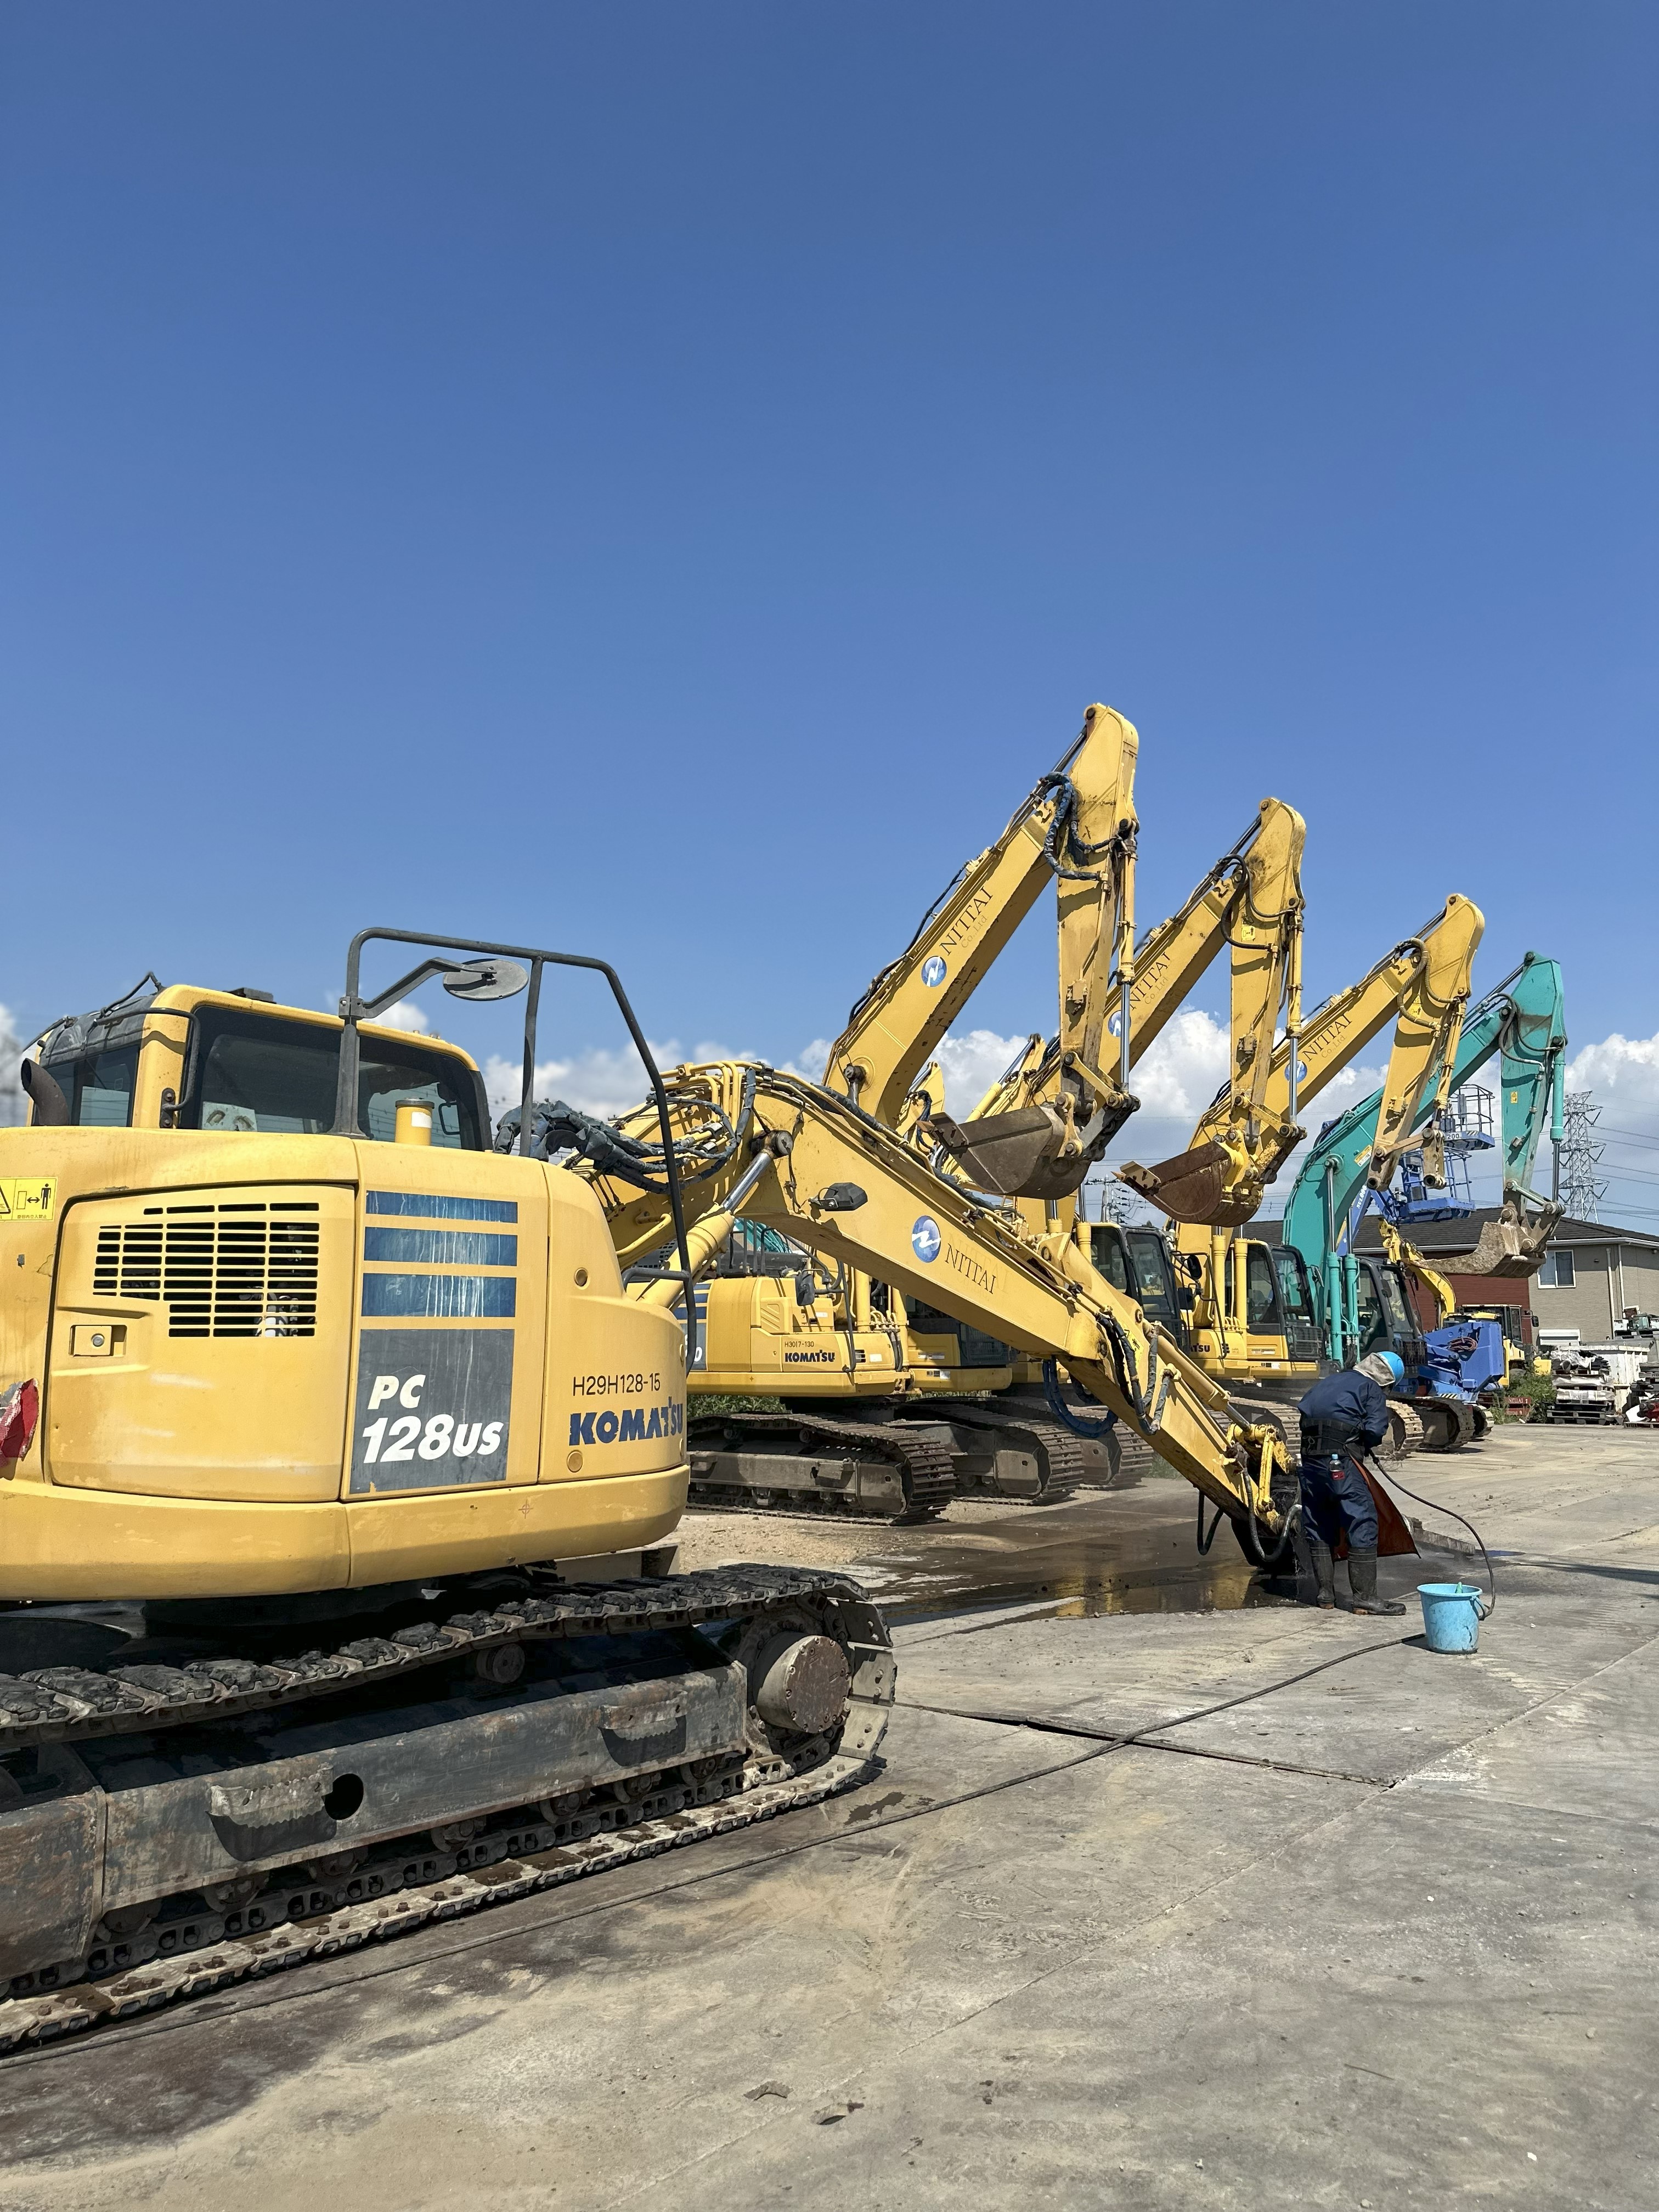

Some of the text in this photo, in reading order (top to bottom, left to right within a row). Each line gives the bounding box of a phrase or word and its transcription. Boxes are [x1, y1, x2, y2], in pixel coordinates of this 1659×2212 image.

[939, 885, 993, 956] NITTAI
[1301, 1013, 1352, 1062] NITTAI
[944, 1243, 996, 1295] NITTAI
[785, 1349, 835, 1362] KOMATSU
[1189, 1343, 1210, 1352] ATSU
[367, 1374, 426, 1410] PC
[573, 1373, 661, 1396] H29H128-15
[569, 1396, 683, 1446] KOMATSU
